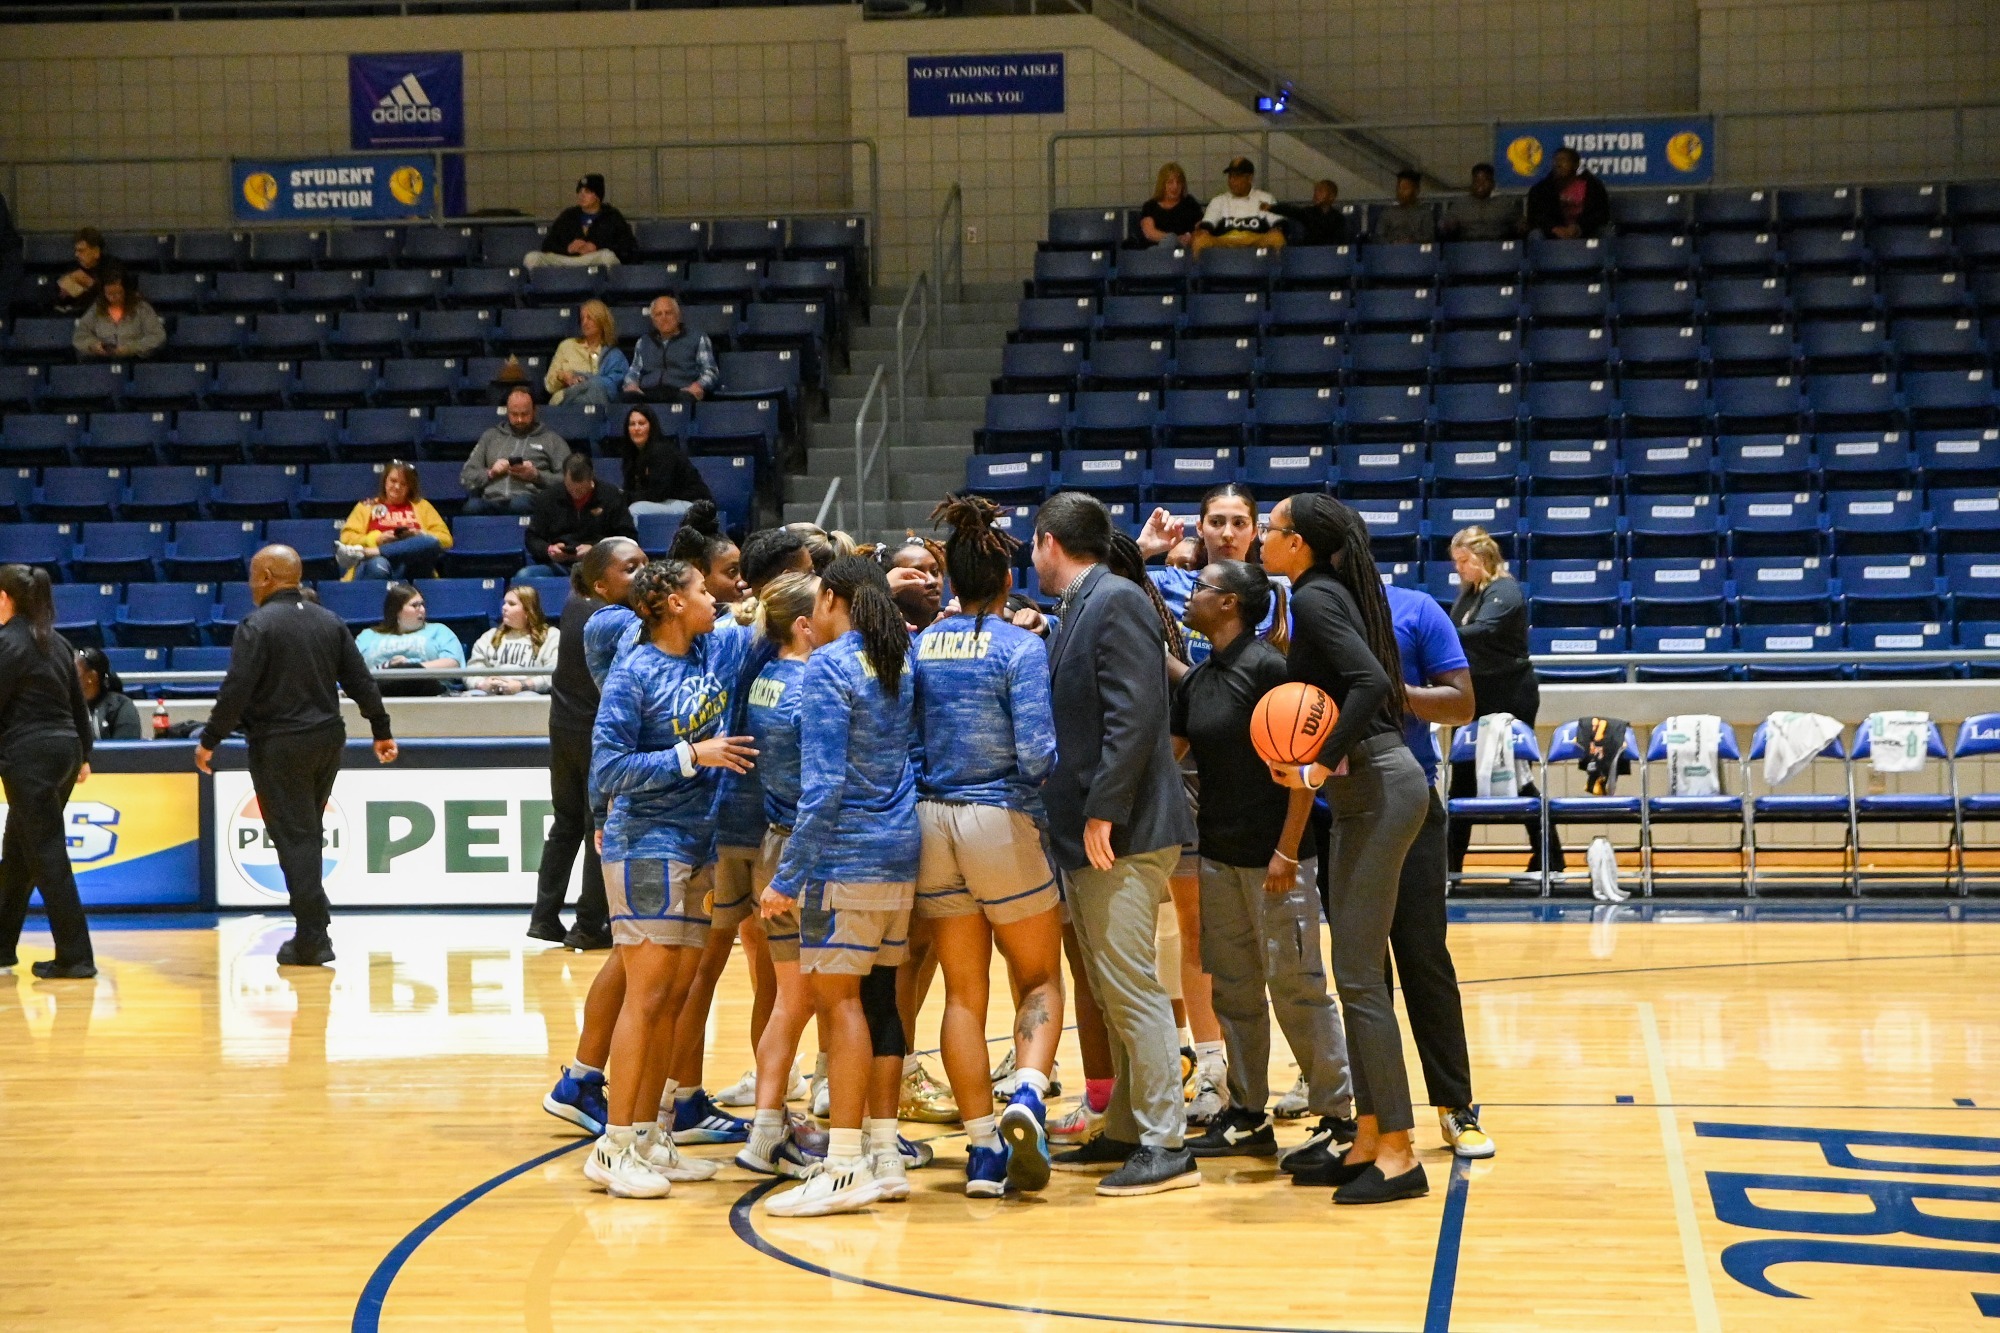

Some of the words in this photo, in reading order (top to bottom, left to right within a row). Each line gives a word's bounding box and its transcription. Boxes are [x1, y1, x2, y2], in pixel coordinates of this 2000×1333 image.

[913, 67, 932, 79] NO
[935, 65, 1000, 79] STANDING
[1003, 64, 1018, 77] IN
[1021, 63, 1059, 77] AISLE
[947, 91, 994, 105] THANK
[997, 91, 1024, 104] YOU
[372, 106, 442, 124] adidas
[1563, 132, 1645, 151] VISITOR
[1576, 155, 1647, 175] CTION
[290, 166, 375, 187] STUDENT
[293, 190, 373, 210] SECTION
[1224, 217, 1260, 229] POLO
[990, 464, 1026, 474] RESERVED
[1083, 461, 1120, 470] RESERVED
[1176, 460, 1213, 469] RESERVED
[1271, 458, 1309, 467] RESERVED
[917, 631, 992, 660] BEARCATS
[238, 828, 339, 849] PEI
